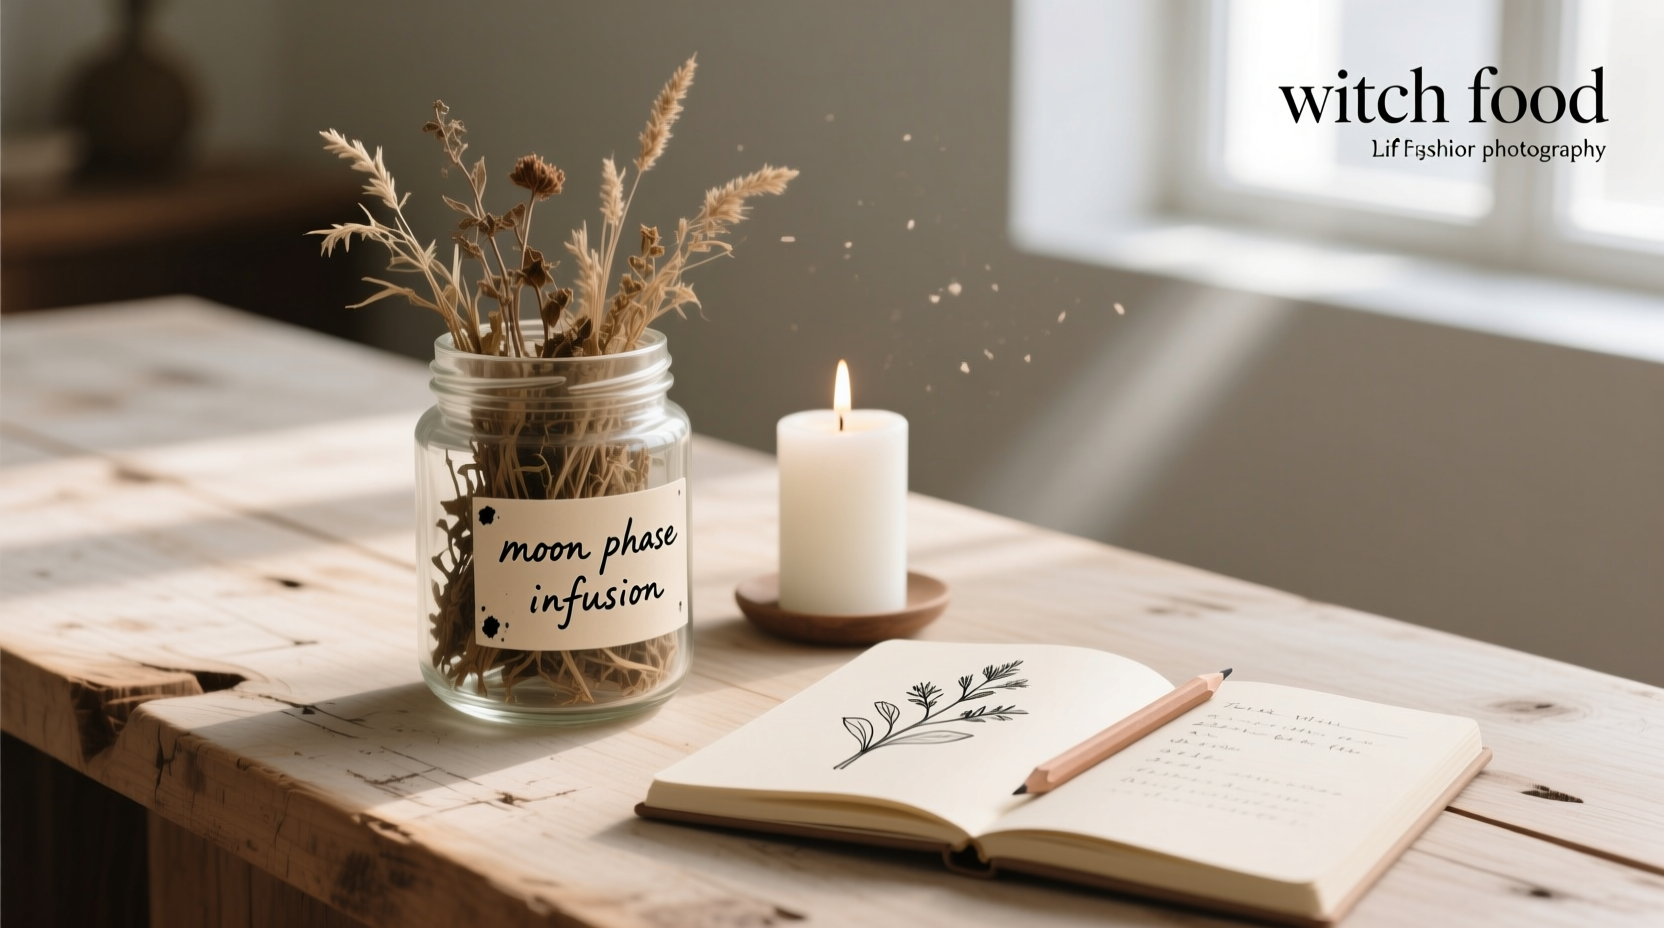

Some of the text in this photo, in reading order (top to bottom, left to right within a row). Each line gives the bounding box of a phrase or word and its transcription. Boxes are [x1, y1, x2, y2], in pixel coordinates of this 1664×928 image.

[499, 516, 678, 576] moon phase
[530, 575, 665, 630] infusion
